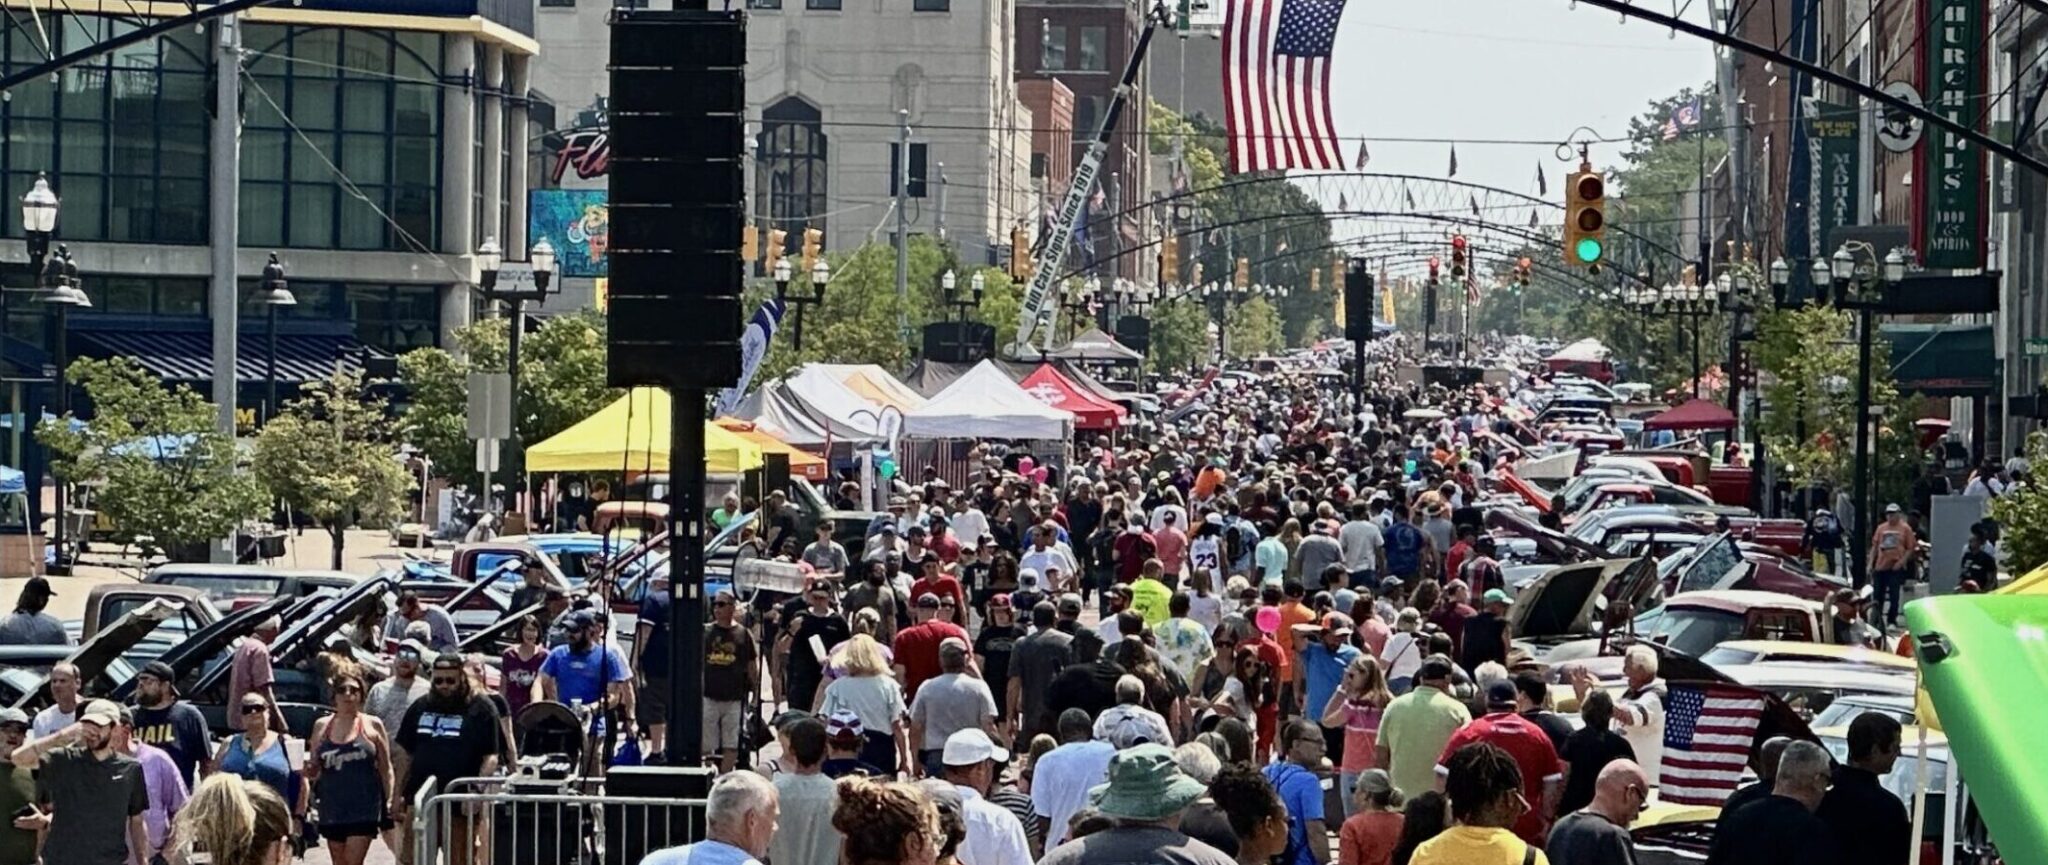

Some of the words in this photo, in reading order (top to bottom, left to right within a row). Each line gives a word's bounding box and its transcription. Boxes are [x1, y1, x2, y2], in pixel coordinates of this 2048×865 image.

[1942, 6, 1966, 190] HURCHILL'S
[1025, 285, 1043, 314] Bill
[1034, 263, 1055, 291] Carr
[1045, 227, 1069, 263] Signs
[1059, 194, 1082, 229] Since
[1074, 163, 1094, 194] 1919
[1196, 553, 1218, 569] 23
